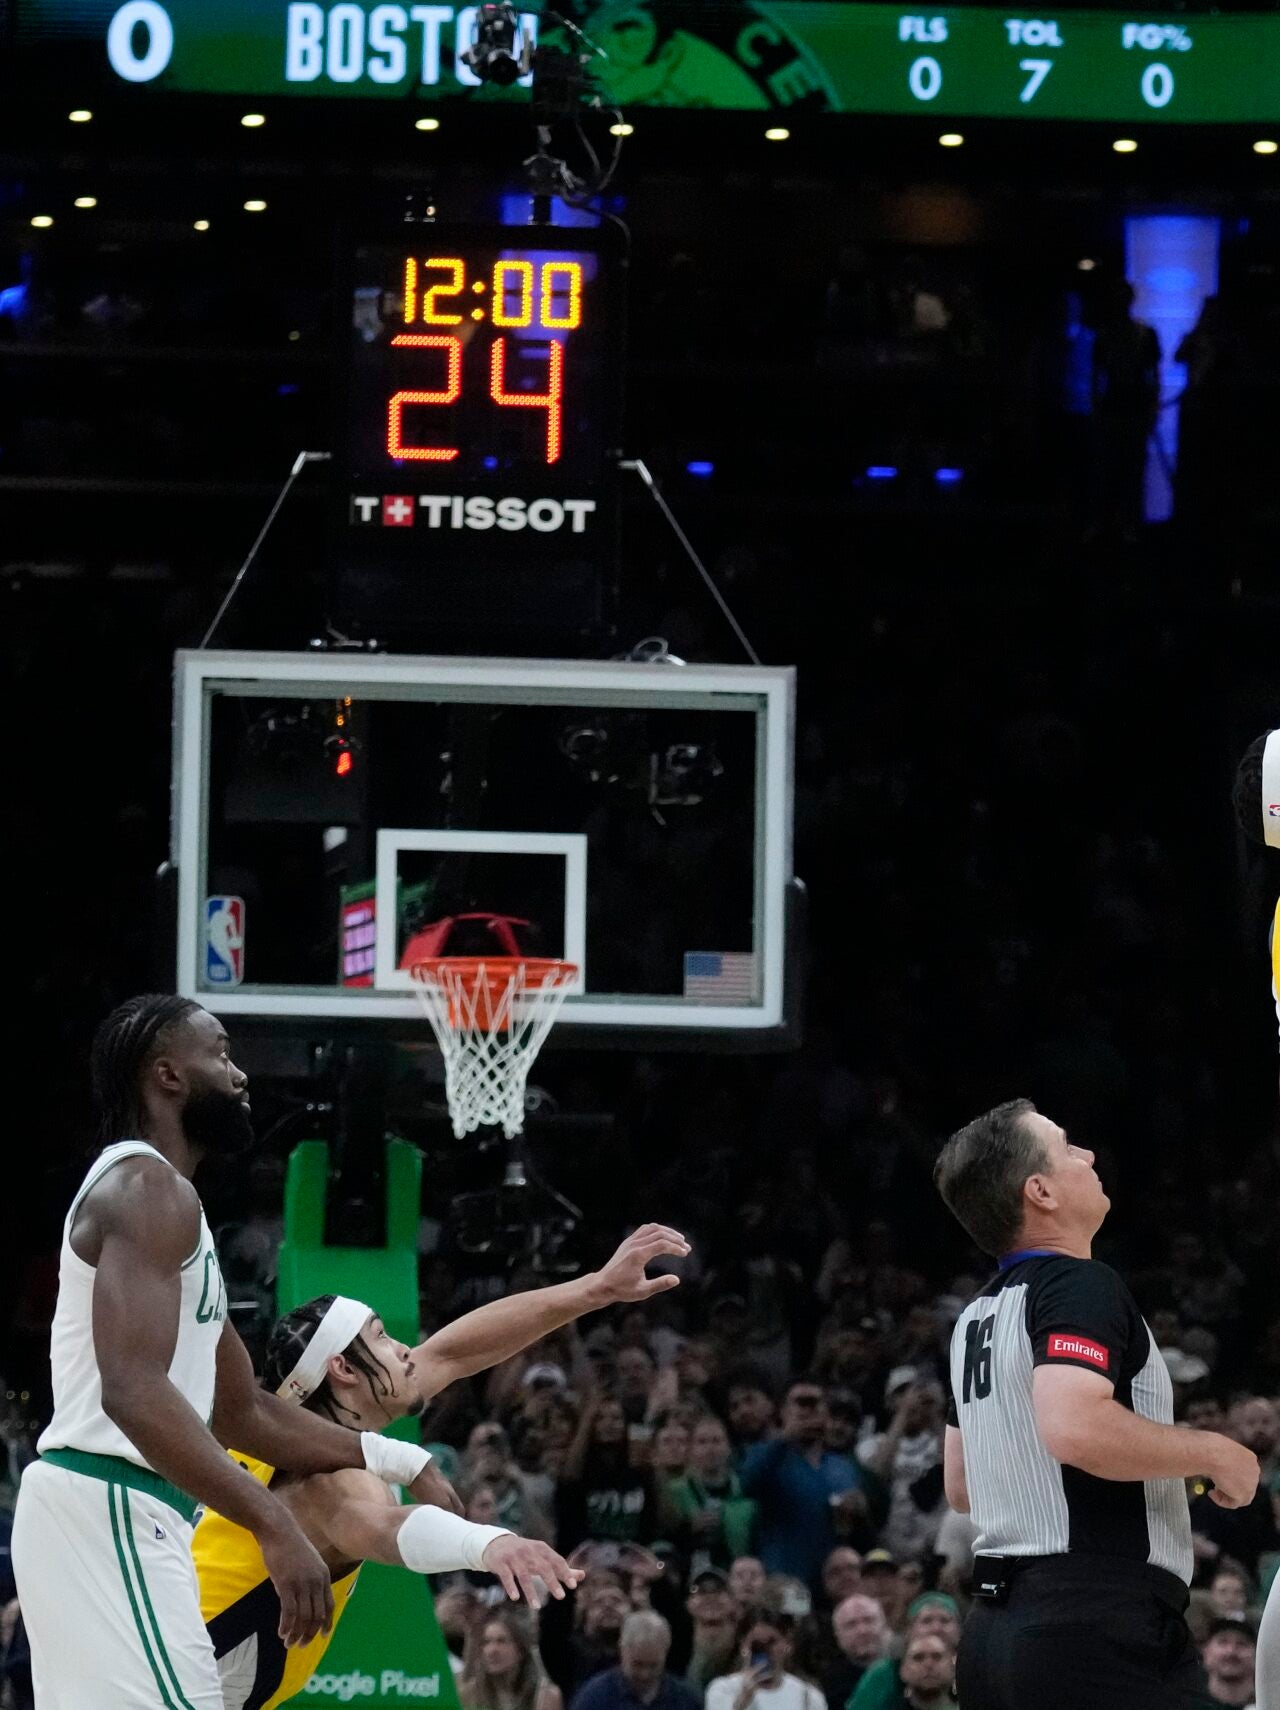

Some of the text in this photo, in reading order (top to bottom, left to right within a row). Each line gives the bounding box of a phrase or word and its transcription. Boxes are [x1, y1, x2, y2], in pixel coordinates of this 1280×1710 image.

[107, 0, 173, 82] 0
[900, 16, 947, 43] FLS
[1006, 20, 1062, 47] TOL
[1123, 23, 1191, 51] FG%
[909, 57, 941, 100] 0
[1020, 59, 1052, 102] 7
[1142, 63, 1174, 107] 0
[403, 257, 582, 328] 12:00
[387, 334, 563, 463] 24
[354, 496, 596, 533] T TISSOT
[962, 1313, 995, 1404] 16
[1053, 1338, 1105, 1362] Emirates
[304, 1669, 440, 1702] oogle Pixel
